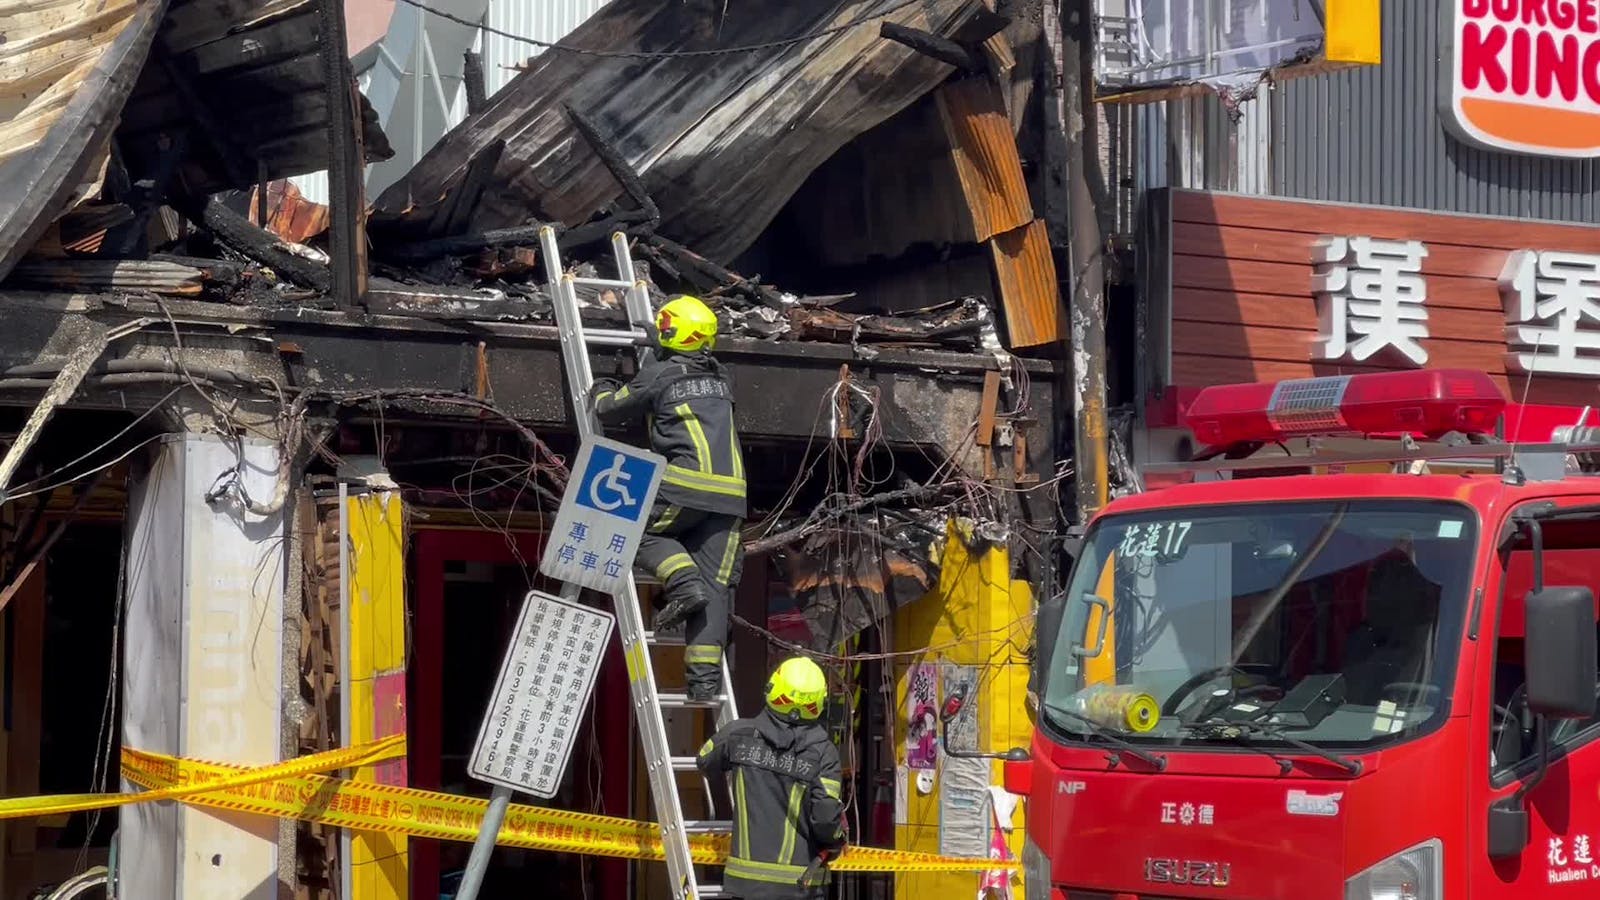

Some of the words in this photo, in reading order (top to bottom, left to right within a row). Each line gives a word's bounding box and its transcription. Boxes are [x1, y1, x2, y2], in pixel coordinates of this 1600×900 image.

[569, 521, 627, 554] 專用
[556, 543, 623, 579] 停車位
[736, 743, 812, 776] 花蓮縣消防
[1058, 780, 1086, 794] NP
[1144, 857, 1231, 887] ISUZU
[1549, 868, 1588, 883] Hualien
[1591, 864, 1600, 878] C
